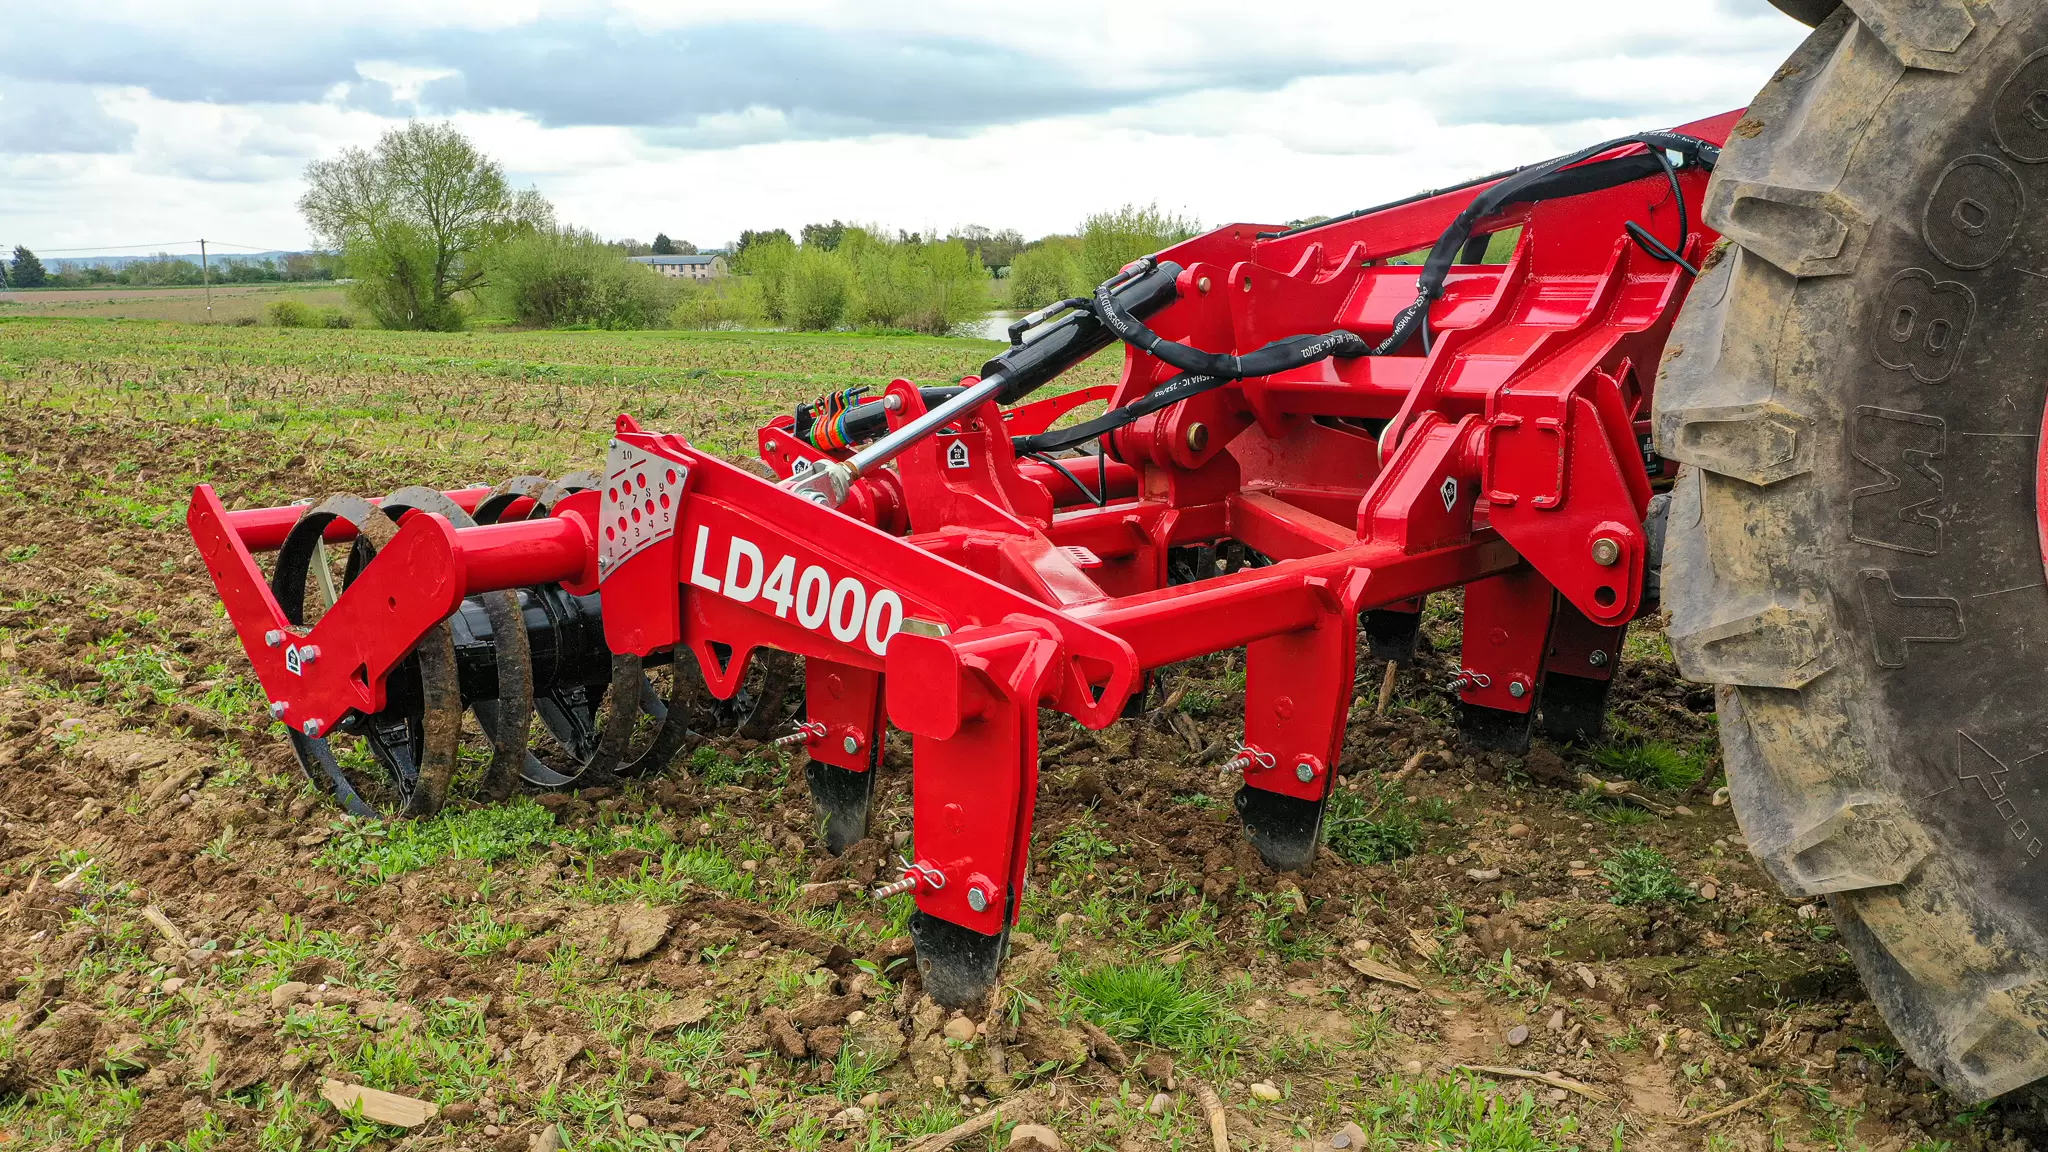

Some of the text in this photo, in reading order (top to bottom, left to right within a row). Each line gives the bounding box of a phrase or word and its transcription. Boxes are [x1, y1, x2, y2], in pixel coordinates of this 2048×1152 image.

[1394, 316, 1411, 335] MSHA
[1300, 343, 1323, 358] 252/02
[622, 450, 633, 461] 10
[619, 501, 625, 511] 6
[632, 494, 638, 503] 7
[659, 482, 665, 493] 9
[609, 512, 669, 558] 1 2 3 4 5
[690, 525, 904, 656] LD4000
